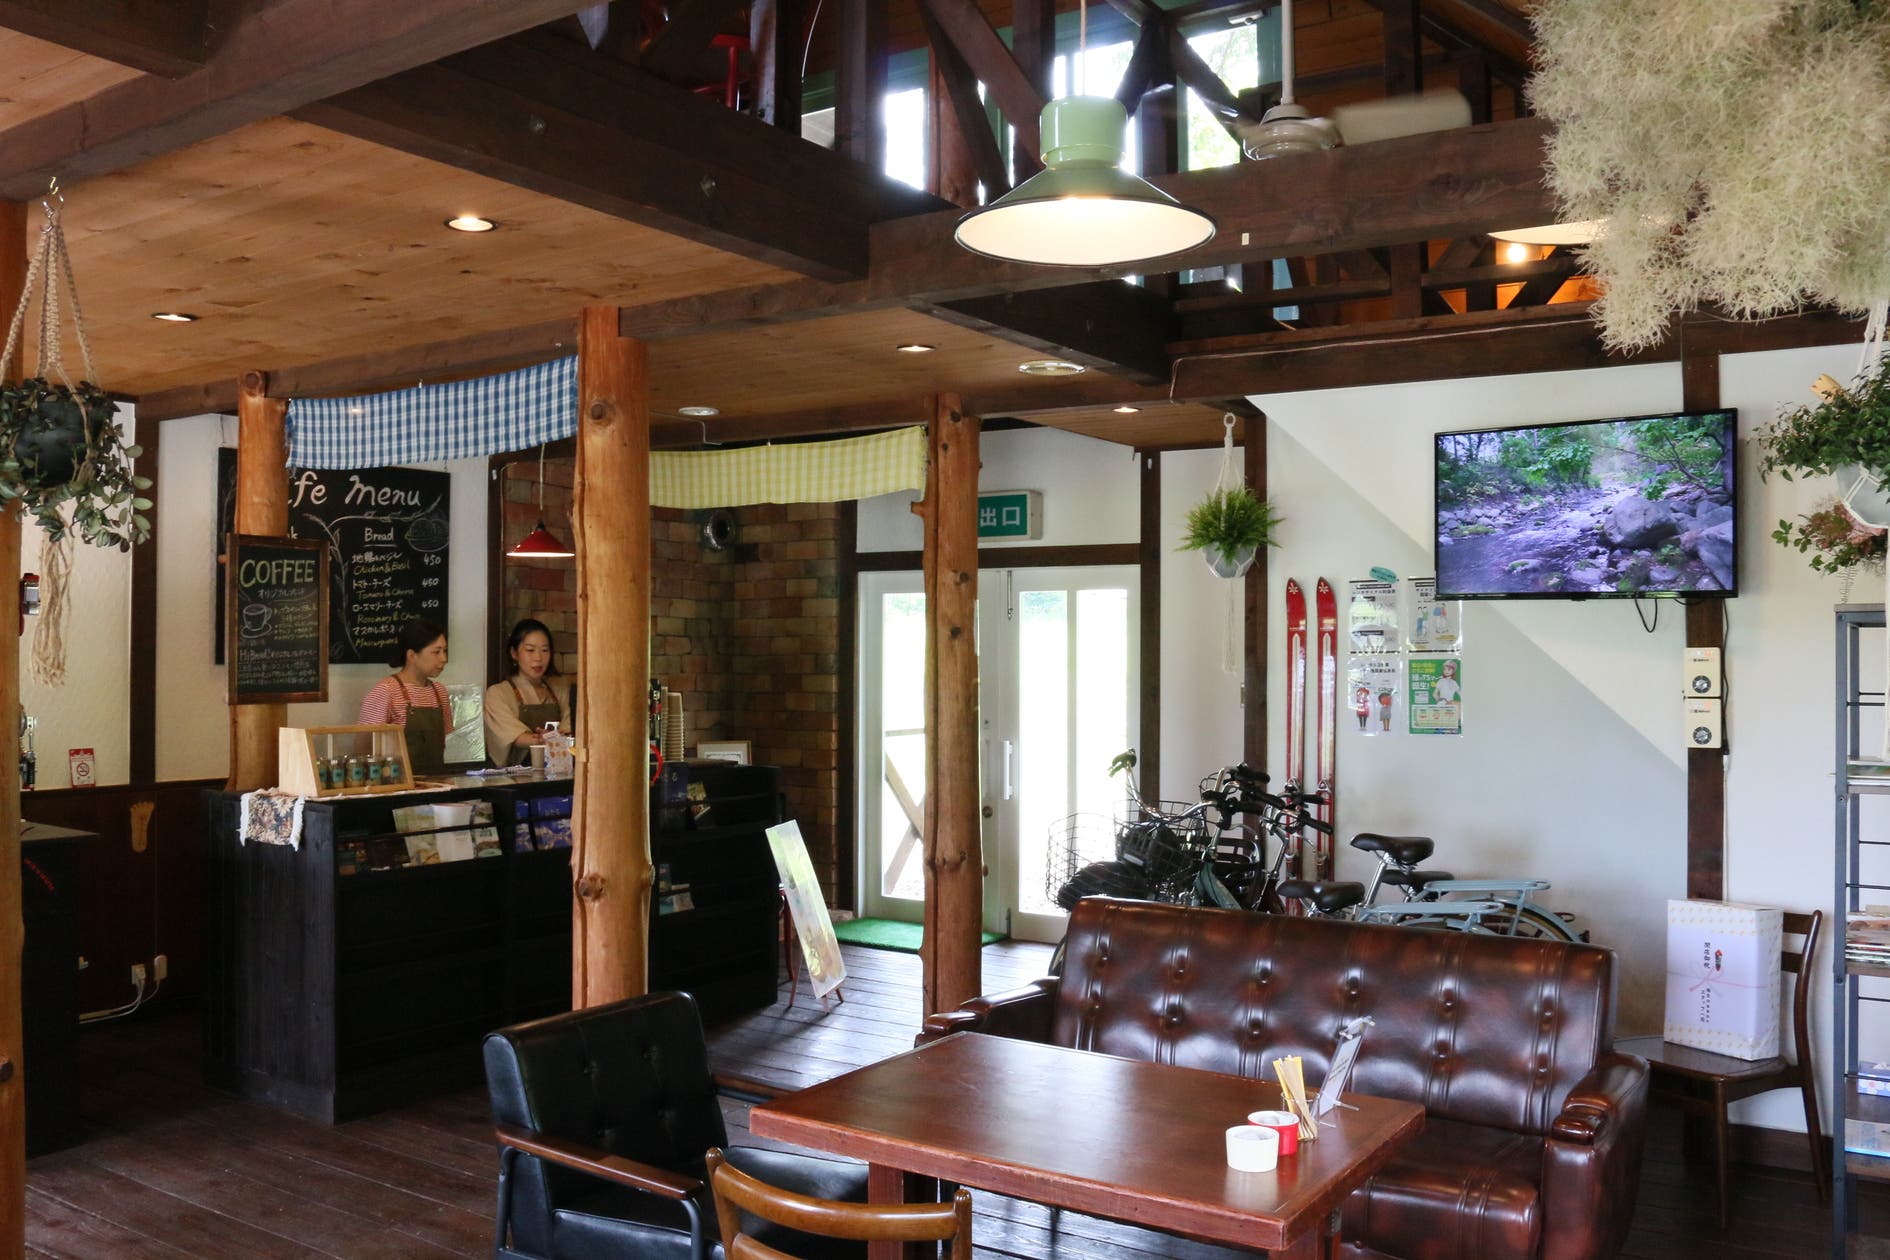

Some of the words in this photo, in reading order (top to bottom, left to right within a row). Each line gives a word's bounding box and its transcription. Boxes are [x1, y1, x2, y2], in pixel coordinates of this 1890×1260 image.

[980, 506, 1021, 527] 出口
[423, 554, 442, 566] 450
[240, 559, 316, 588] COFFEE
[421, 578, 440, 588] 450
[421, 599, 440, 609] 450
